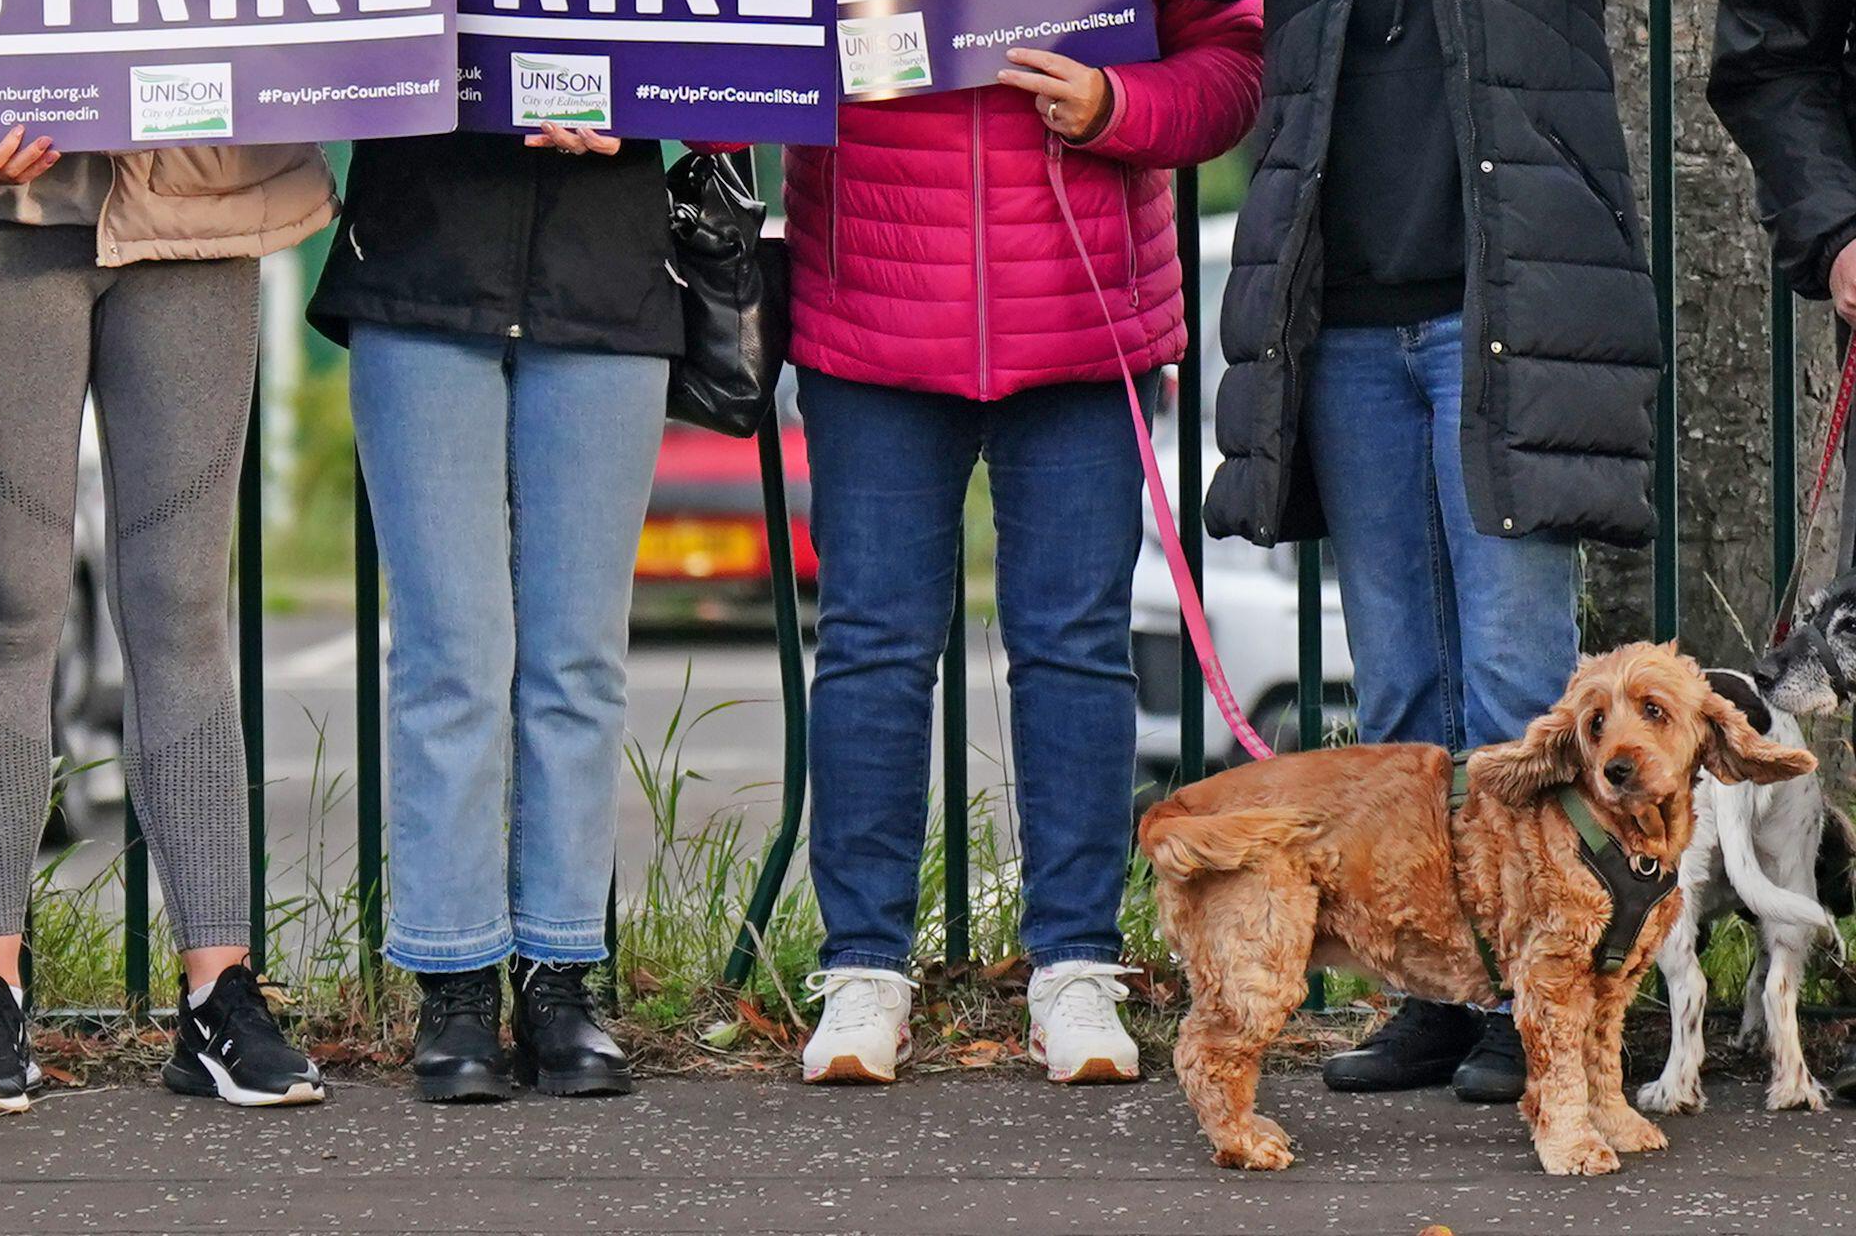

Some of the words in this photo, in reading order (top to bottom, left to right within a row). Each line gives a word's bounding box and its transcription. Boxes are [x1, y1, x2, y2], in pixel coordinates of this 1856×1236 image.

[952, 8, 1136, 50] #PayUpForCouncilStaff
[140, 82, 223, 102] UNISON
[257, 79, 440, 105] #PayUpForCouncilStaff
[521, 72, 601, 92] UNISON
[522, 95, 542, 108] City
[544, 95, 556, 108] of
[557, 95, 608, 109] Edinburgh
[635, 84, 820, 105] #PayUpForCouncilStaff
[0, 107, 99, 126] @unisonedin
